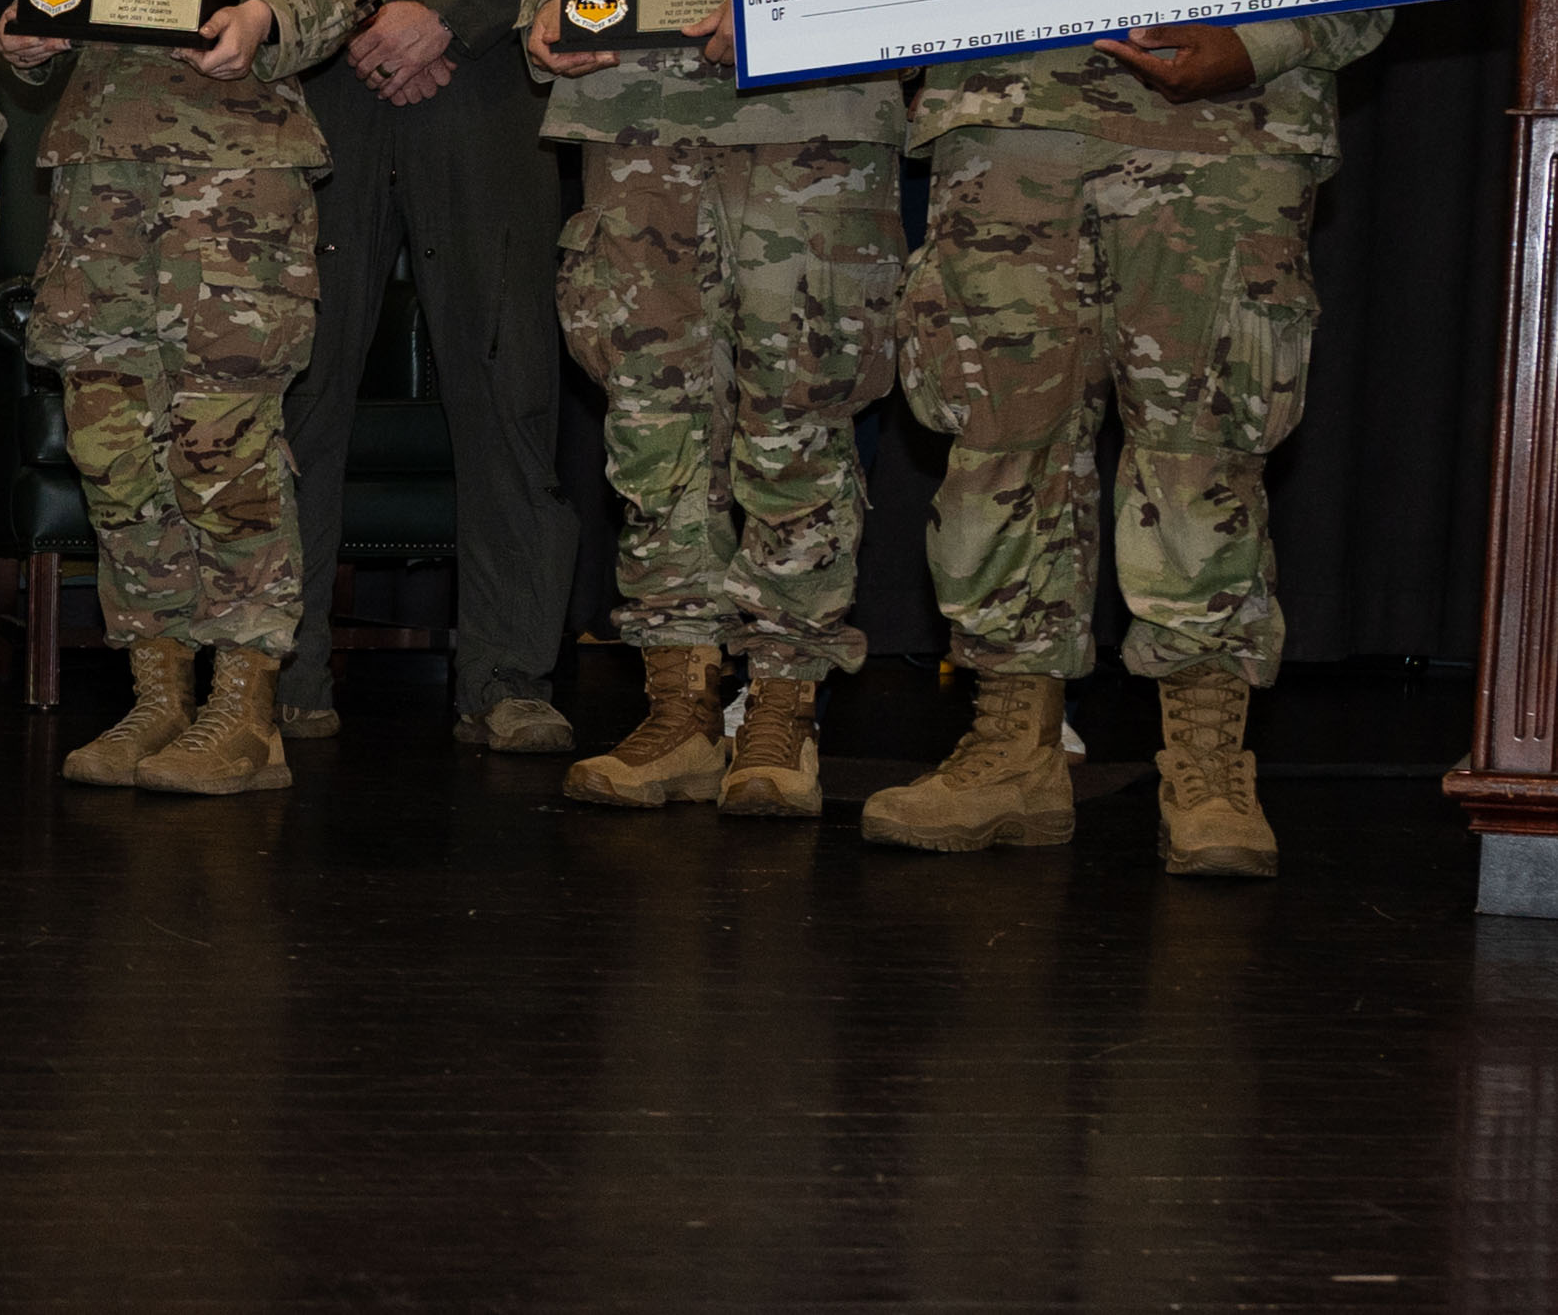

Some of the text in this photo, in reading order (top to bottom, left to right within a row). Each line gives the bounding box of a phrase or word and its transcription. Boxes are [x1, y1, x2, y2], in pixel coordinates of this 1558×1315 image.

[772, 7, 785, 21] OF
[1188, 3, 1224, 19] 607
[1231, 1, 1241, 12] 7
